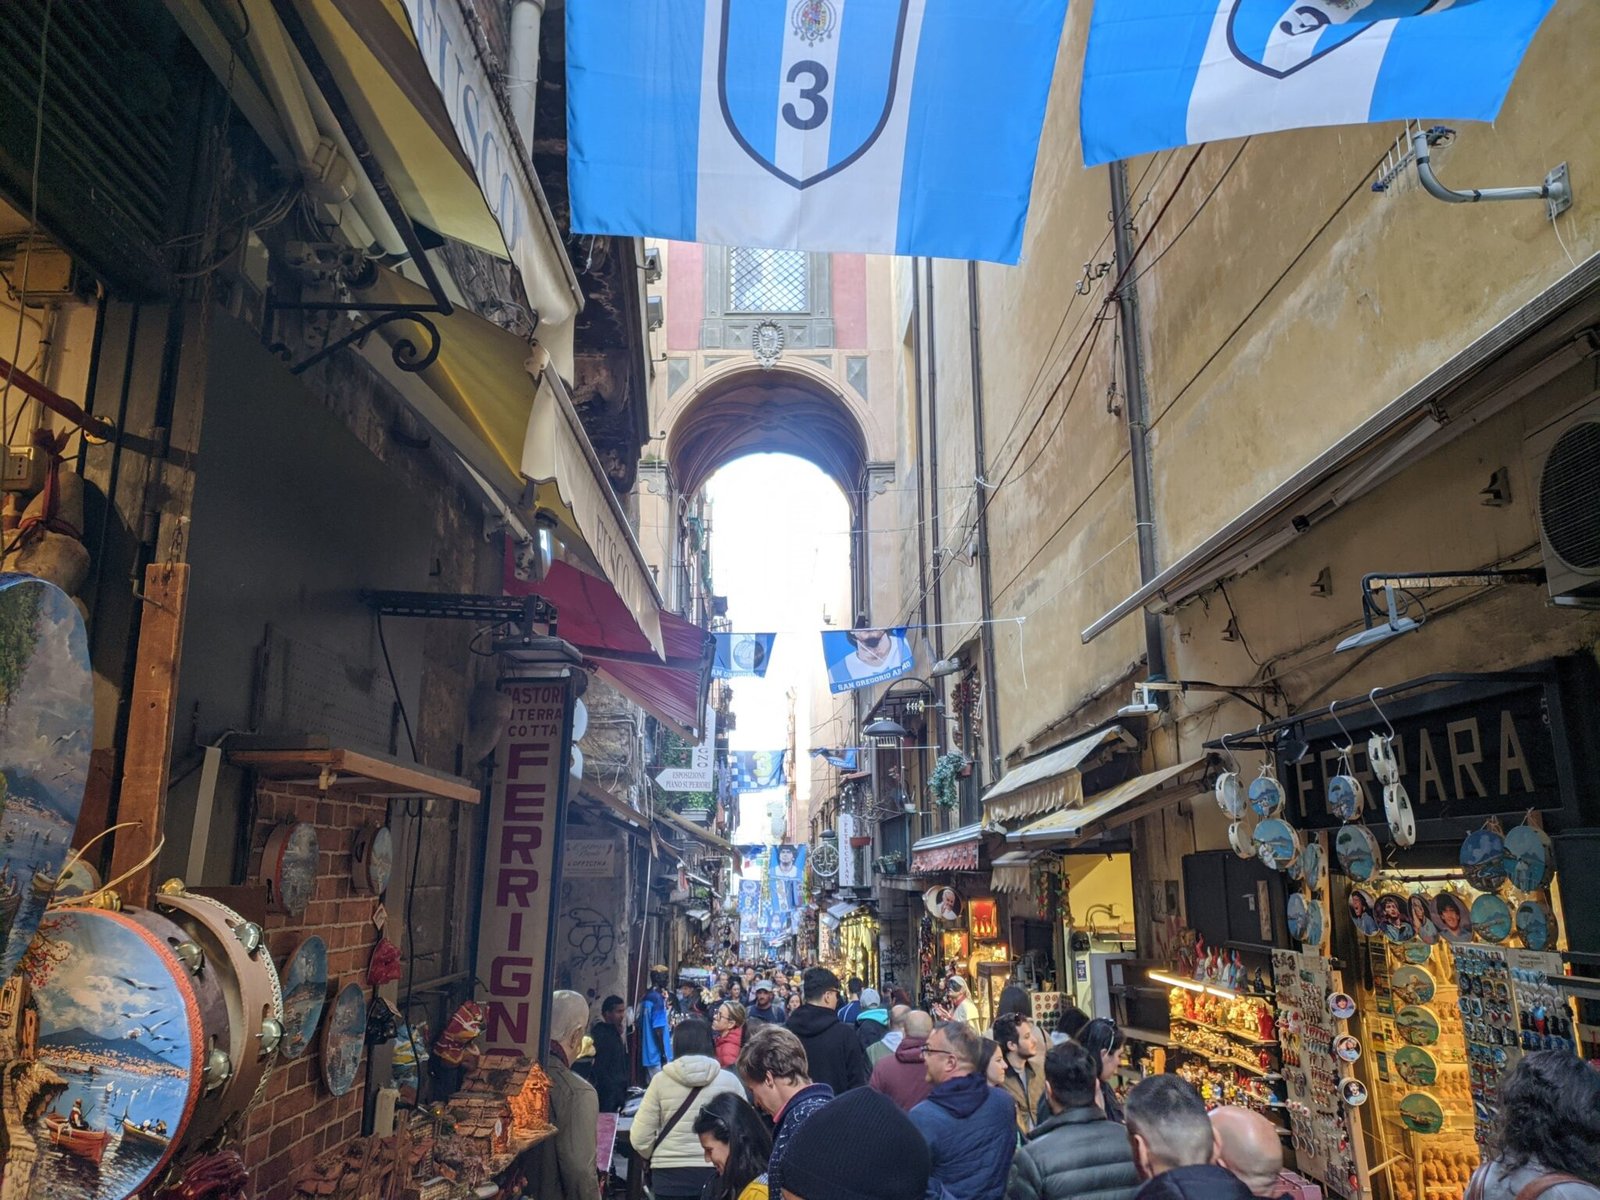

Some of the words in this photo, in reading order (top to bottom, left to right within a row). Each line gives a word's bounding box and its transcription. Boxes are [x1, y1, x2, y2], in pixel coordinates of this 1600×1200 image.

[781, 59, 829, 130] 3
[837, 682, 855, 692] SAN
[517, 708, 563, 721] TERRA
[507, 724, 558, 737] COTTA
[672, 772, 706, 780] ESPOSIZIONE
[665, 780, 682, 788] PIANO
[682, 780, 711, 789] SUPERIORE
[486, 743, 550, 1057] FERRIGN
